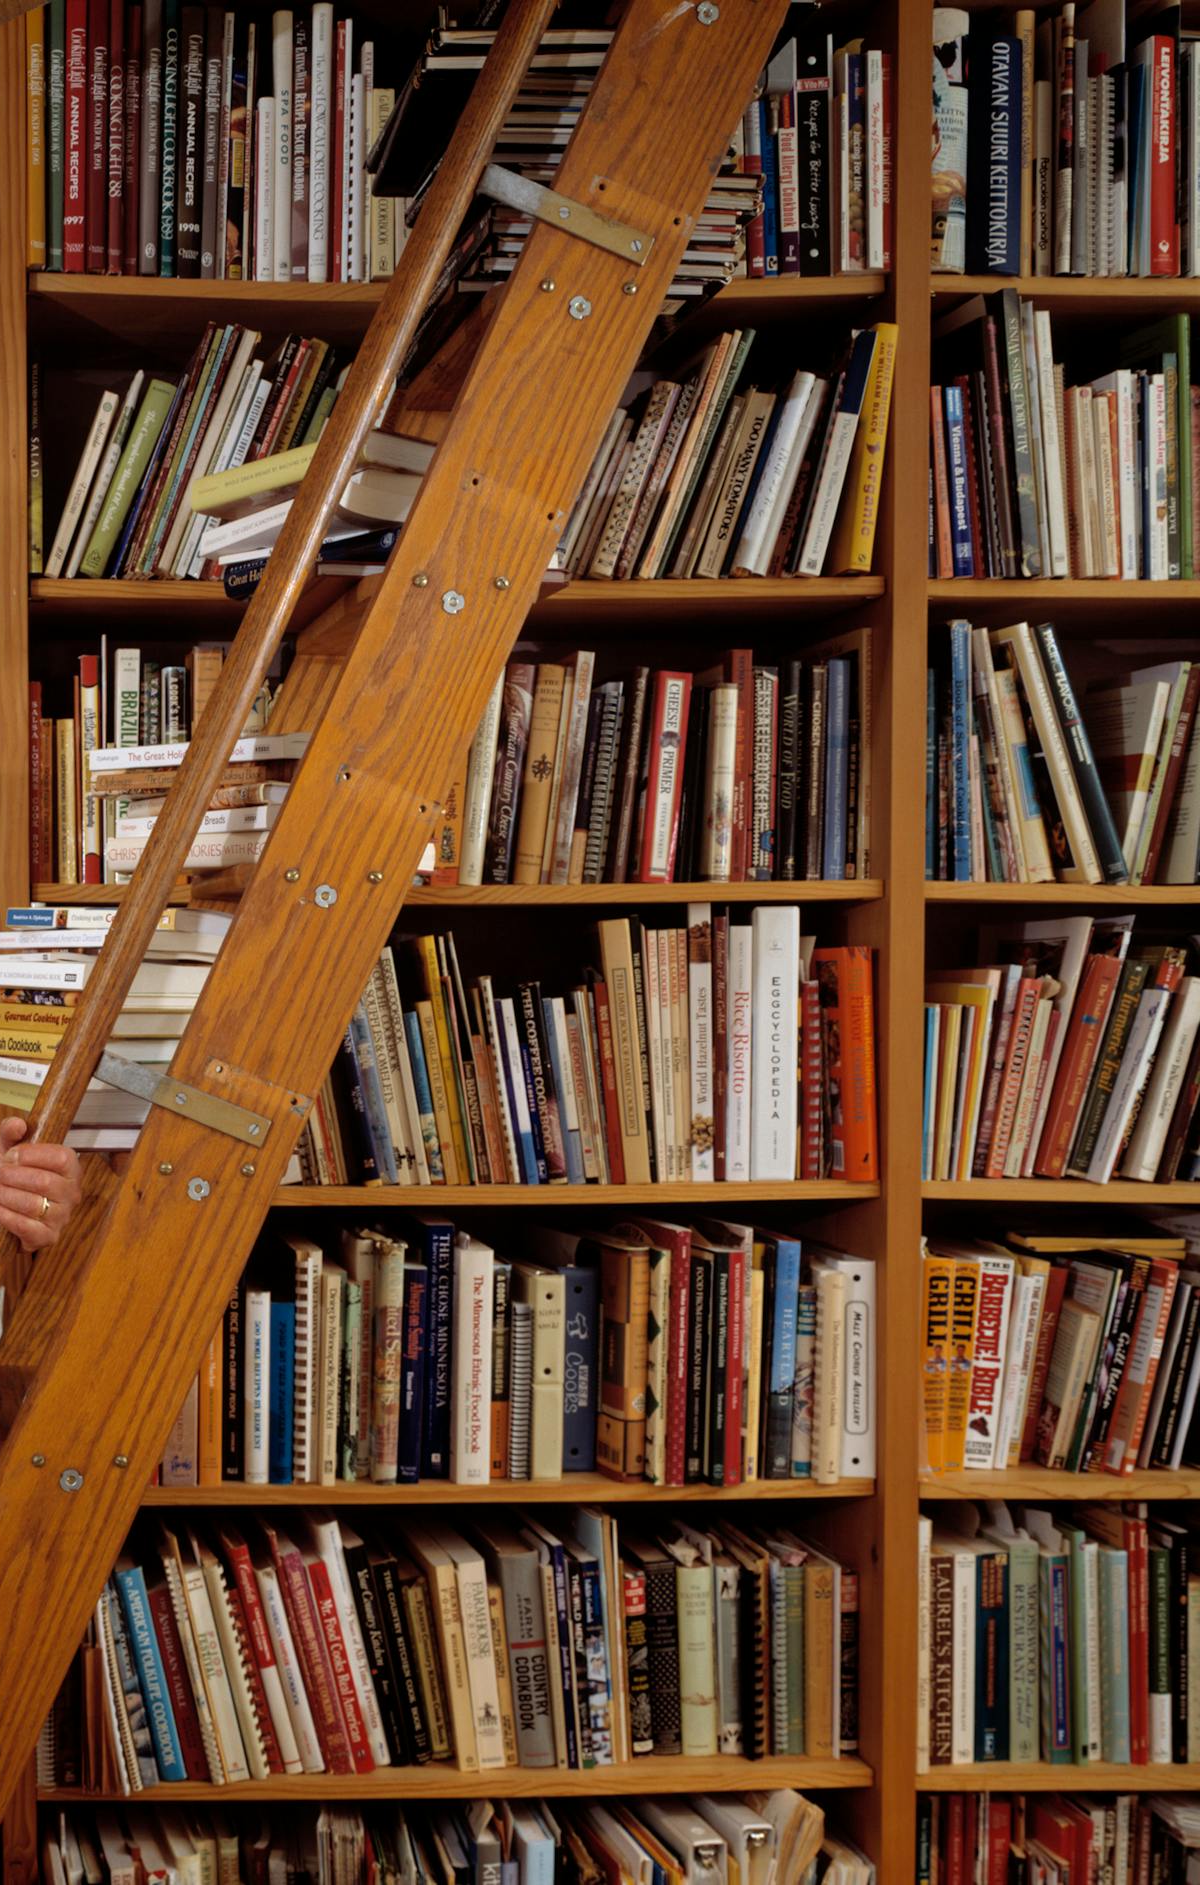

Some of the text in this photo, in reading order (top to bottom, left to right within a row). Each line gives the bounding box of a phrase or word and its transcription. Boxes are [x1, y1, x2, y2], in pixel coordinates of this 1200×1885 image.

[64, 96, 83, 224] ANNUAL RECIPES 1997
[281, 90, 289, 165] SPA FOOD
[985, 42, 1009, 267] OTAVAN SUURI KEITTOKIRJA
[1159, 47, 1170, 163] LEIVONTAKIRJA
[779, 132, 797, 228] Food Allergy Cookbook
[809, 160, 820, 191] Better
[717, 416, 766, 540] TOO MANY TOMATOES
[859, 463, 878, 537] organic
[951, 425, 963, 465] Vienna
[953, 477, 968, 530] Budapest
[498, 706, 522, 838] American Country Cheese
[660, 684, 680, 794] CHEESE PRIMER
[952, 680, 967, 836] Book of Savoury Cooking
[205, 817, 226, 826] Breads
[7, 1037, 42, 1053] Cookbook
[520, 989, 554, 1154] THE COFFEE COOKBOOK
[732, 991, 749, 1094] Rice Risotto
[771, 977, 781, 1119] EGGCYCLOPEDIA
[1097, 975, 1142, 1092] The Turmeric Trail
[435, 1233, 450, 1408] THEY CHOSE MINNESOTA
[470, 1275, 484, 1453] The Minnesota Ethnic Food Book
[927, 1274, 950, 1347] GRILL
[952, 1275, 977, 1347] GRILL
[969, 1272, 1009, 1416] BARBECUE! BIBLE
[852, 1311, 864, 1426] MALE CHORUS AUXILIARY
[523, 1597, 533, 1639] FARM
[936, 1563, 951, 1758] LAUREL'S KITCHEN
[127, 1589, 175, 1766] AMERICAN FOLKLIFE COOKBOOK
[515, 1657, 535, 1731] COOKBOOK
[531, 1655, 549, 1716] COUNTRY
